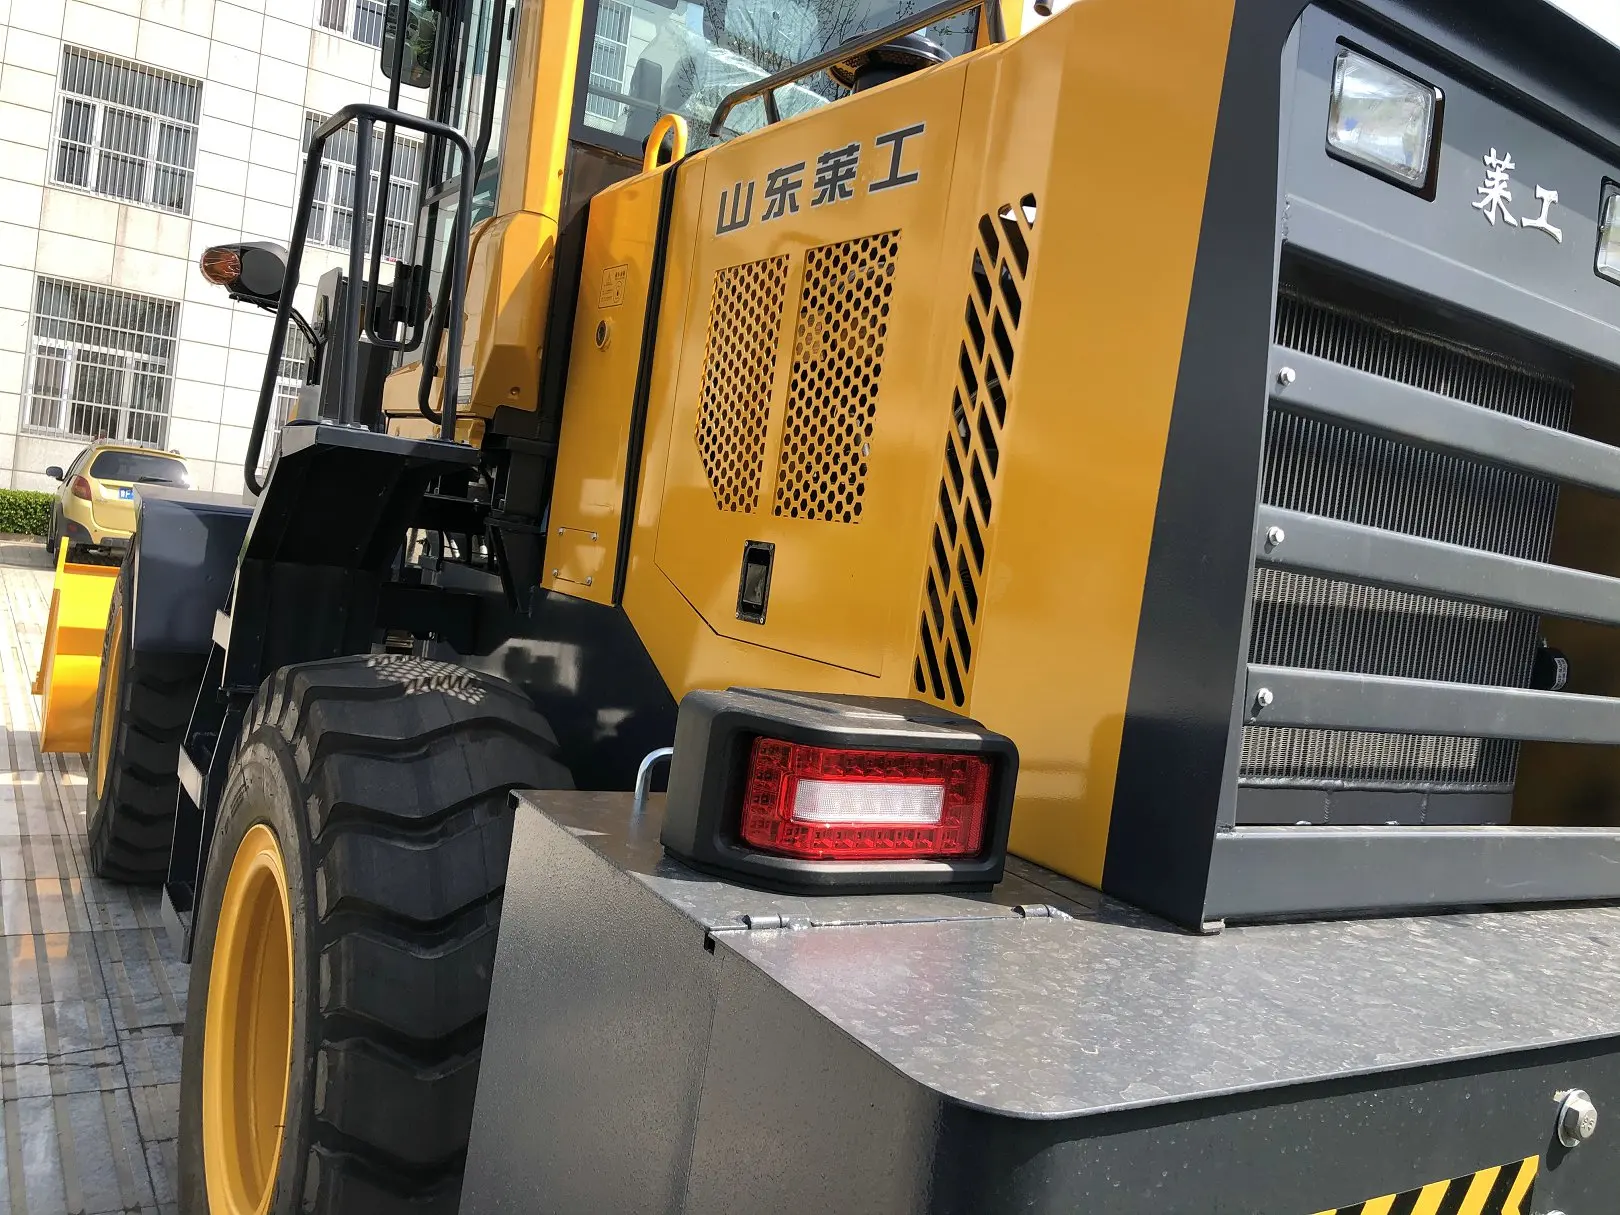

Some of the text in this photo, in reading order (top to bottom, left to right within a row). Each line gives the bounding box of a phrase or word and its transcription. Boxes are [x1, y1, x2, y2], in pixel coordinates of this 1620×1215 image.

[715, 121, 926, 236] 山东莱工
[1471, 147, 1562, 244] 莱工
